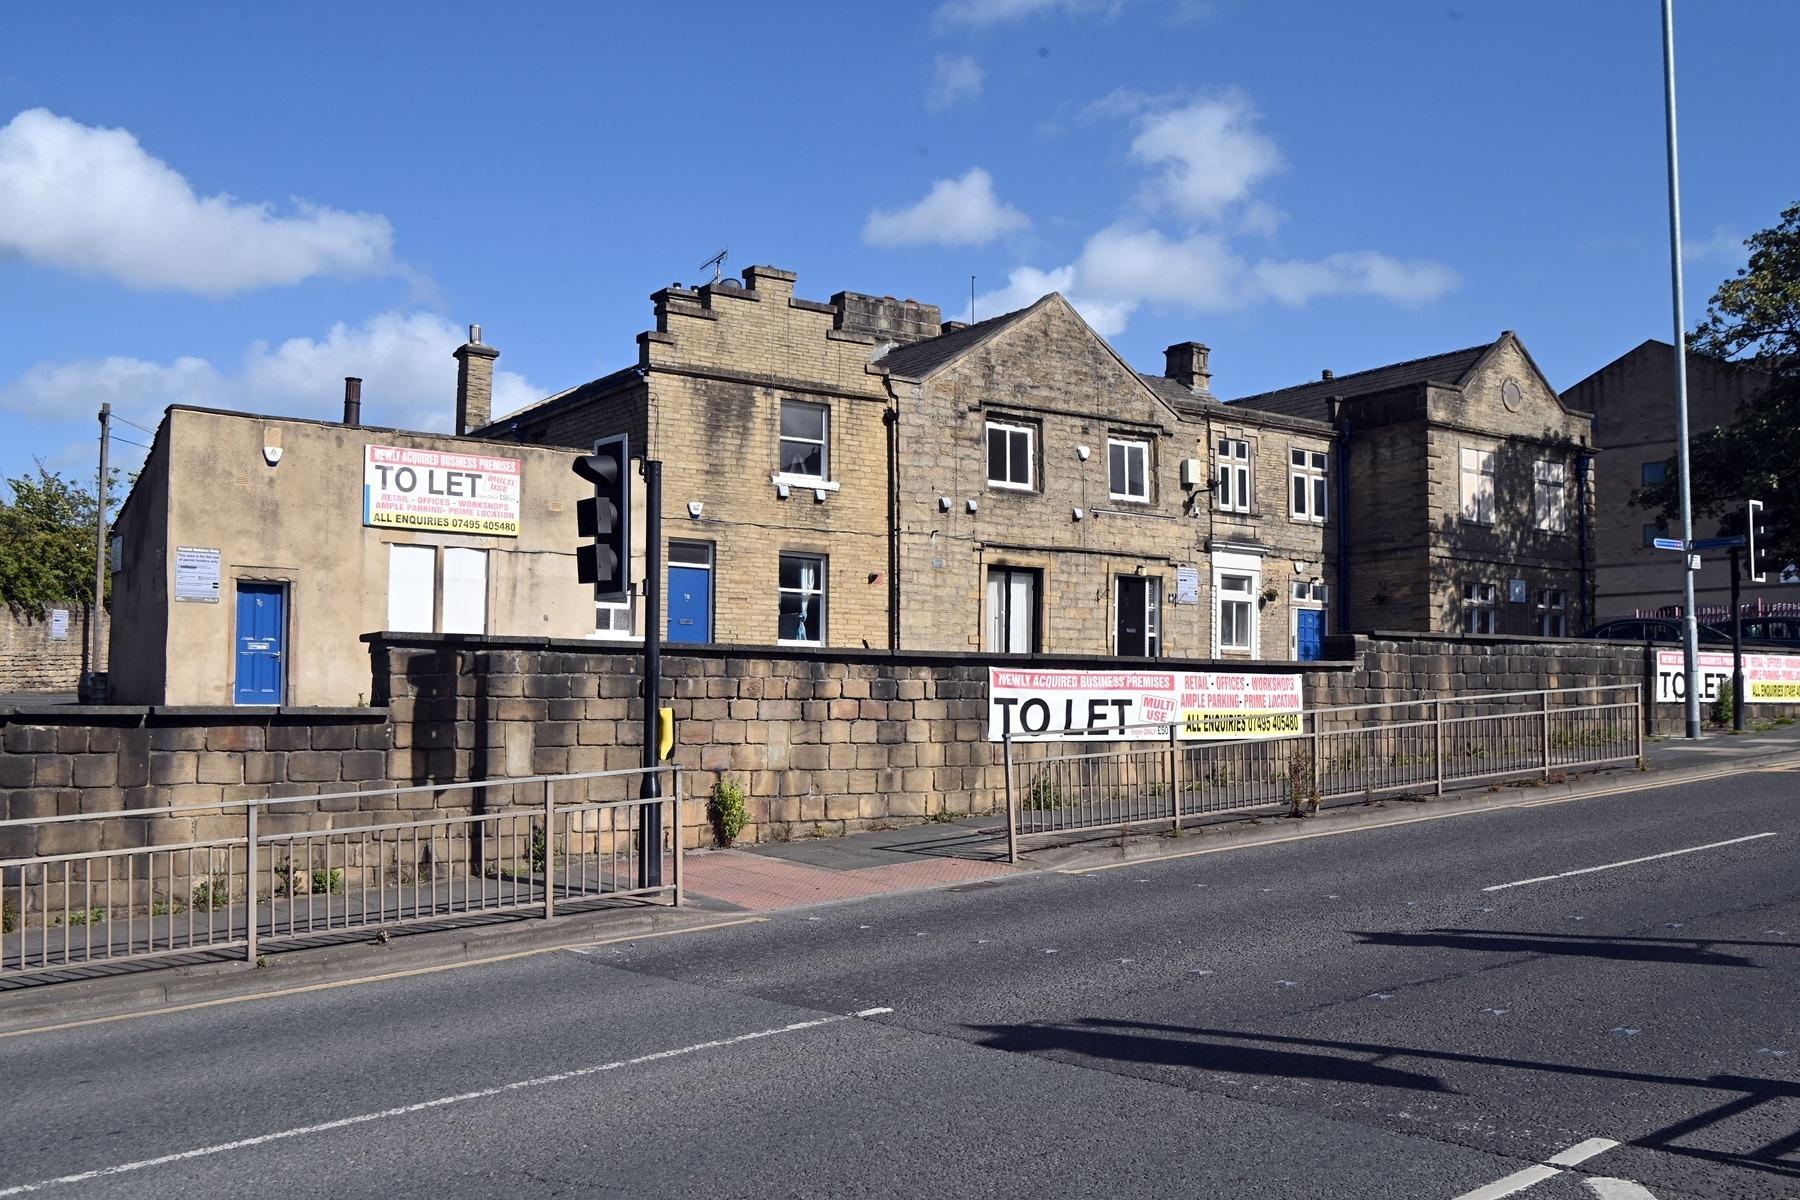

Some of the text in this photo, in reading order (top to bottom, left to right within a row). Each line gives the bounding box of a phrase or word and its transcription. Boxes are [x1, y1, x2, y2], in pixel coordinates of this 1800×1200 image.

[374, 448, 516, 473] NEWLY ACQUIRED BUSINESS PREMISES
[375, 465, 482, 498] TO LET
[488, 475, 515, 486] MULTI
[490, 483, 509, 493] USE
[375, 501, 404, 511] AMPLE
[448, 507, 474, 516] PRIME
[476, 509, 514, 519] LOCATION
[381, 494, 509, 511] RETAIL OFFICES WORKSHOPS
[373, 512, 516, 532] ALL ENQUIRIES 07495 405480
[998, 673, 1170, 688] NEWLY ACQUIRED BUSINESS PREMISES
[1184, 675, 1295, 691] RETAIL OFFICES WORKSHOPS
[1143, 697, 1175, 711] MULTI
[1180, 693, 1205, 708] AMPLE
[1244, 694, 1267, 708] PRIME
[1268, 694, 1299, 708] LOCATION
[994, 697, 1133, 737] TO LET
[1146, 710, 1167, 723] USE
[1185, 714, 1299, 732] ALL ENQUIRIES 07495 405480
[1143, 727, 1156, 736] ONLY
[1157, 725, 1168, 736] £50
